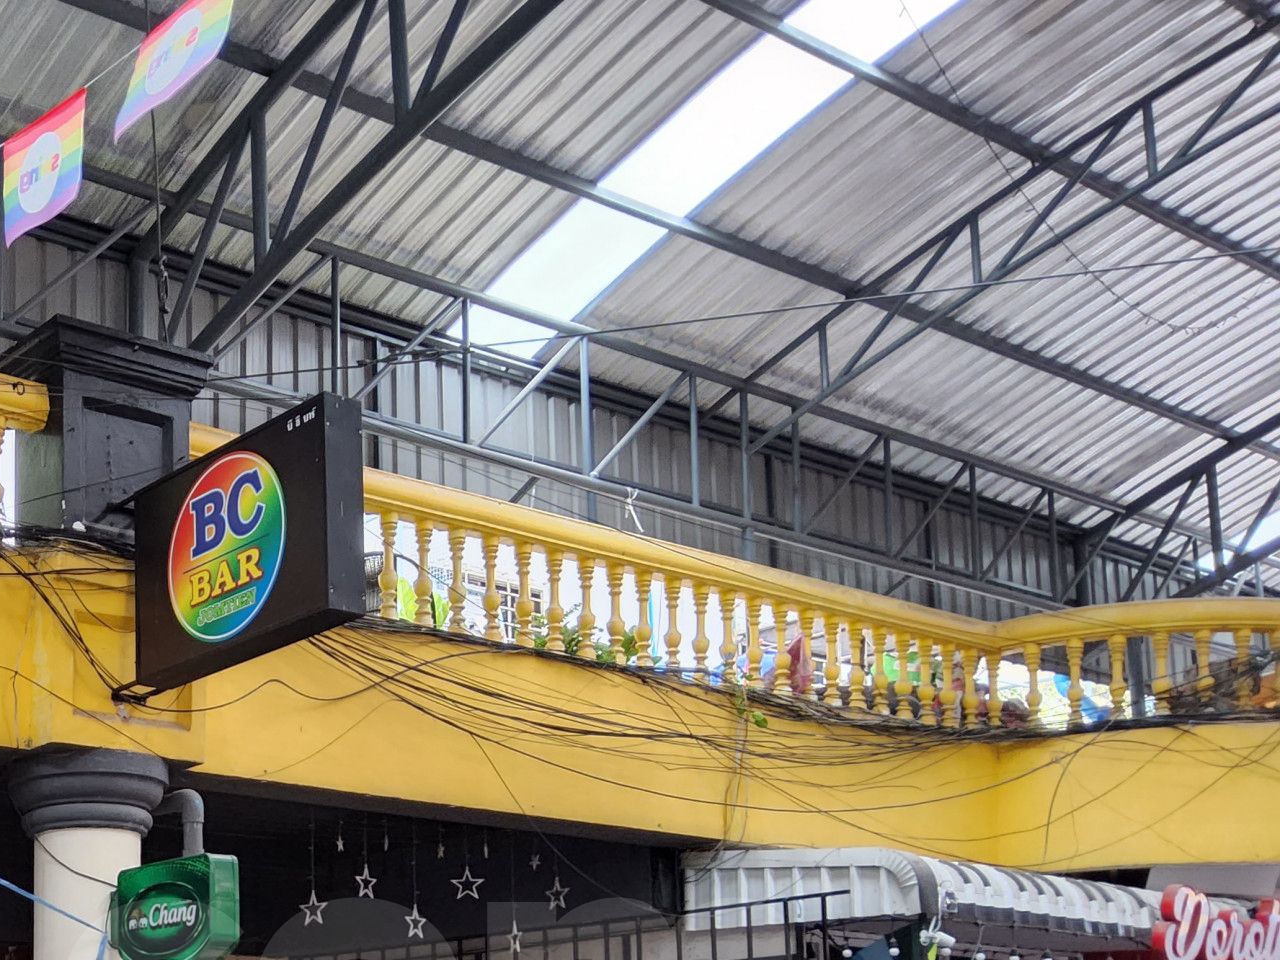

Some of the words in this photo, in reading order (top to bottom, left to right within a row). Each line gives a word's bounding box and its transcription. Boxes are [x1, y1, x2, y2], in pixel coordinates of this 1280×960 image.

[190, 469, 265, 560] BC
[189, 547, 262, 607] BAR
[149, 903, 197, 927] Chang
